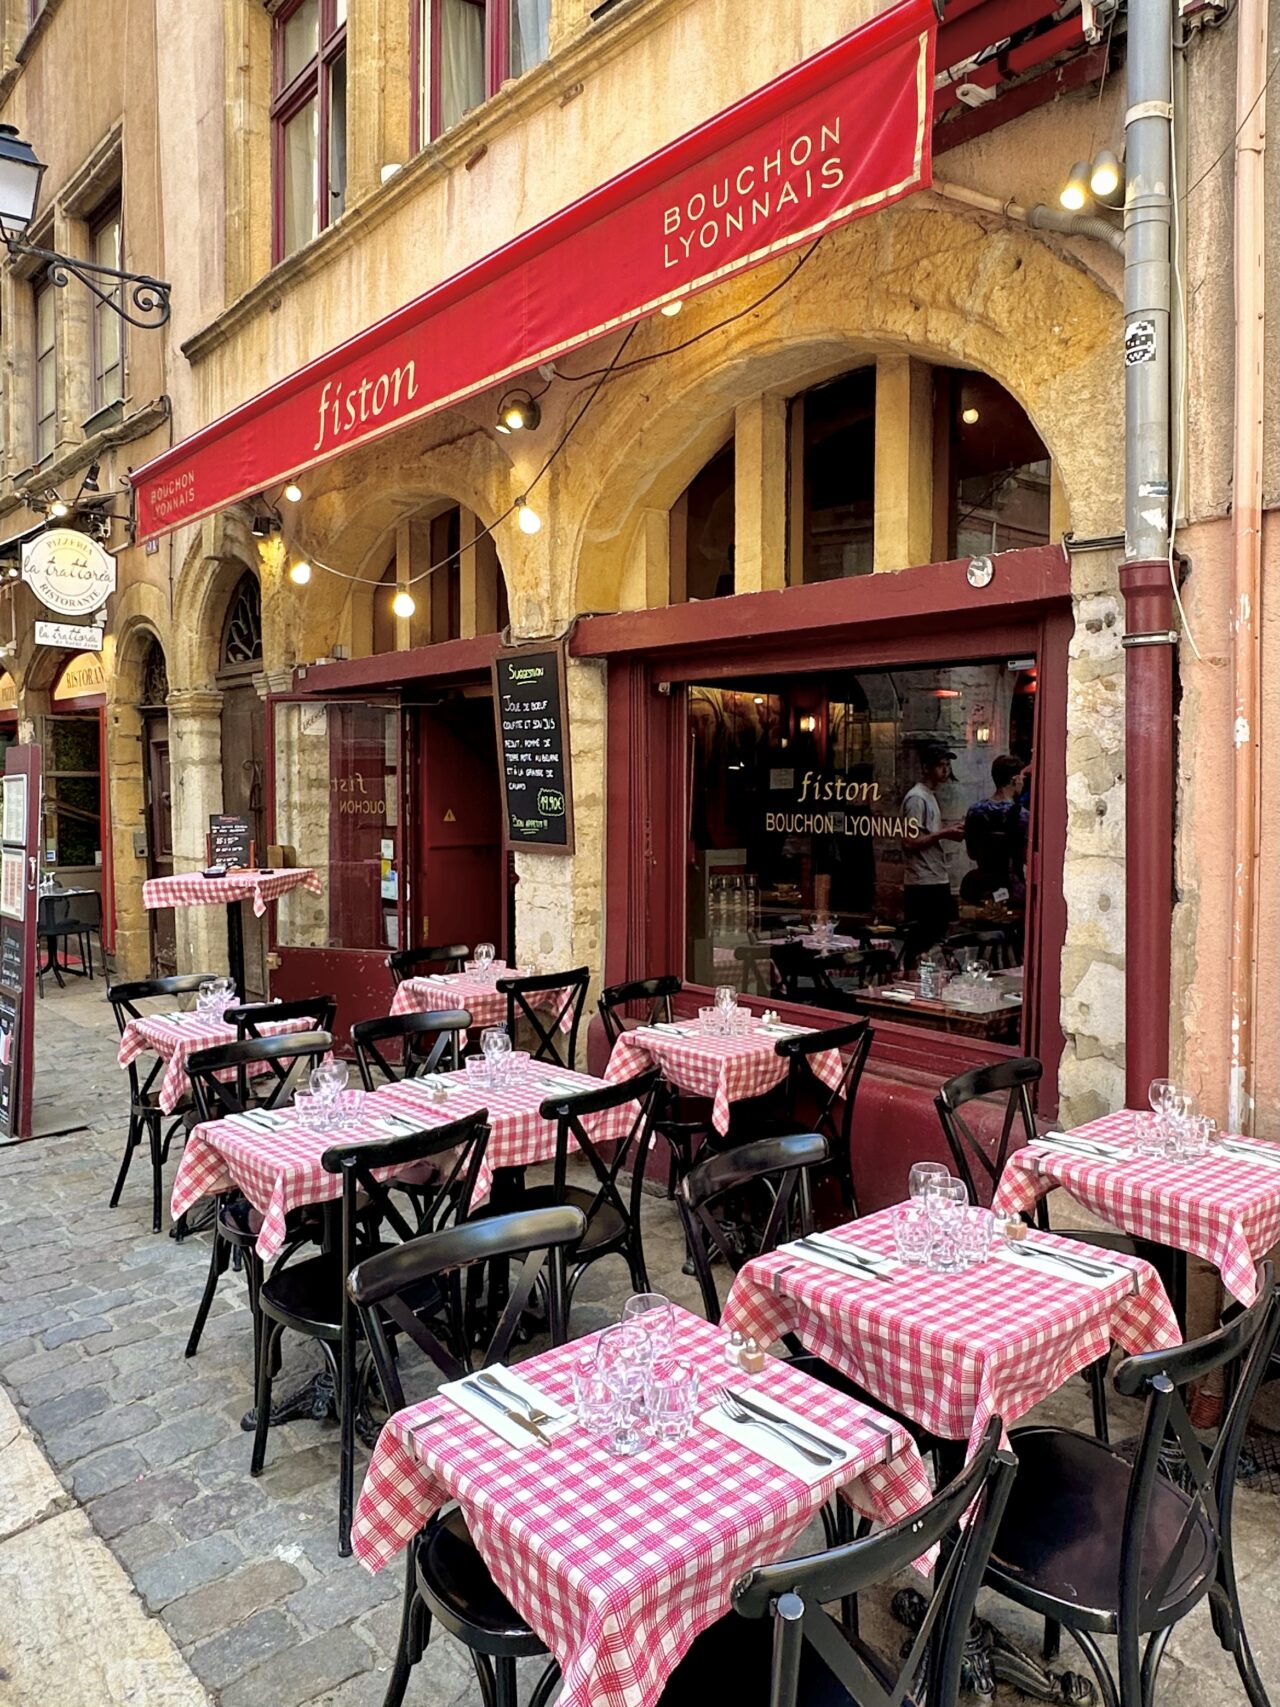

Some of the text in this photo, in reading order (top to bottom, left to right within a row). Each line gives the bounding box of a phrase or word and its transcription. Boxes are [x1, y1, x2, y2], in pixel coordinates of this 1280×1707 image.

[664, 116, 840, 235] BOUCHON
[664, 157, 844, 268] LYONNAIS
[313, 360, 418, 450] fiston
[150, 470, 194, 504] BOUCHON
[152, 488, 195, 520] YONNAIS
[45, 537, 93, 556] PIZZERIA
[23, 554, 40, 575] la
[39, 582, 101, 608] RISTORANTE
[65, 665, 105, 689] RISTORAN
[797, 771, 882, 802] fiston
[766, 812, 920, 839] BOUCHON LYONNAIS
